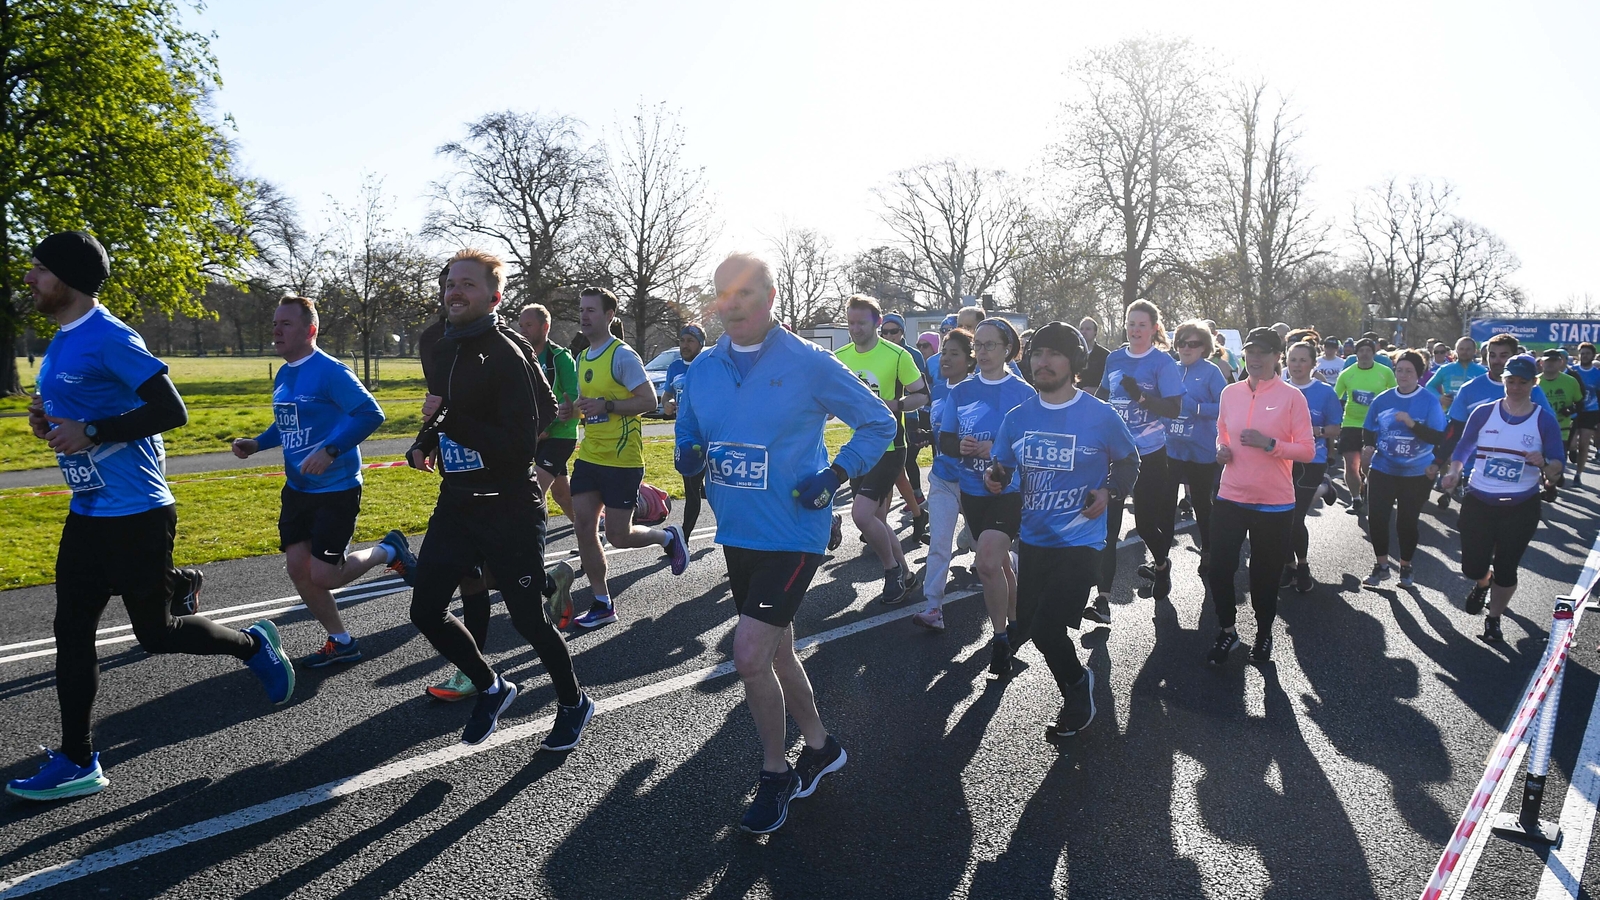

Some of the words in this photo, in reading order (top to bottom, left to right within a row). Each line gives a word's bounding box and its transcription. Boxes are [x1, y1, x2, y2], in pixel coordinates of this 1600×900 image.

[1491, 326, 1509, 334] great
[1548, 322, 1600, 343] START
[1169, 423, 1184, 433] 398
[445, 448, 477, 463] 415
[1025, 445, 1071, 462] 1188
[1395, 444, 1411, 454] 452
[62, 466, 91, 484] 789
[709, 458, 764, 479] 1645
[1488, 464, 1517, 478] 786
[1024, 470, 1055, 494] OUR
